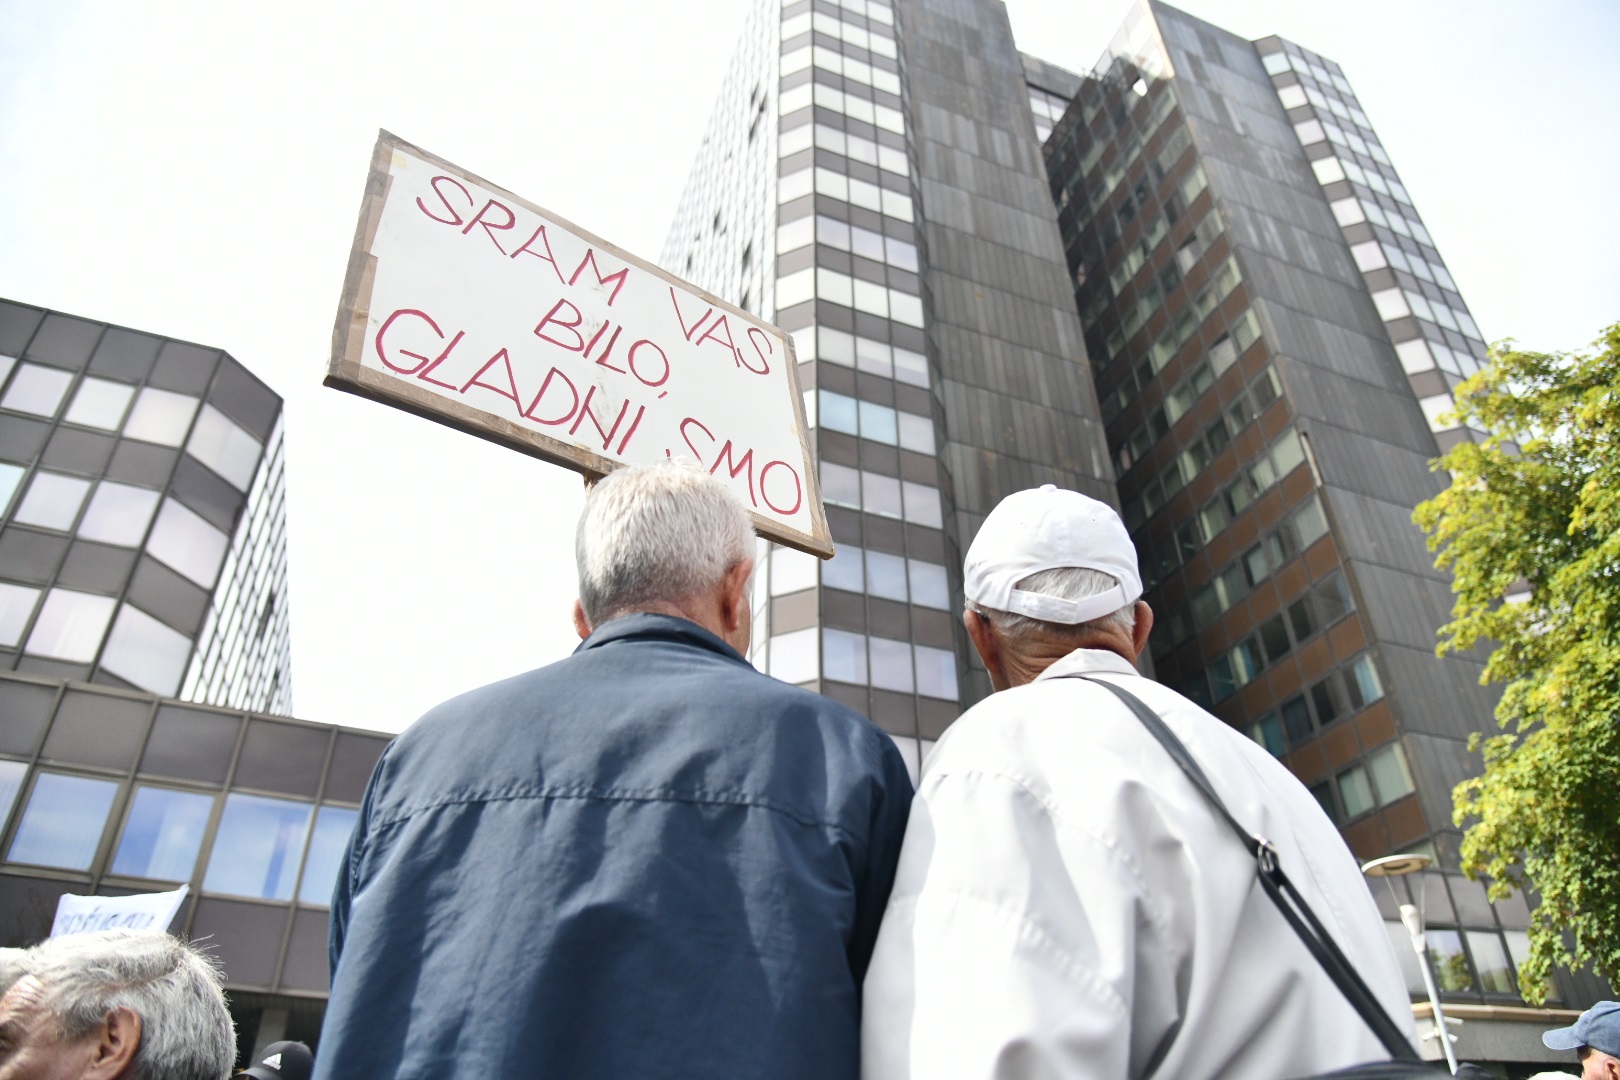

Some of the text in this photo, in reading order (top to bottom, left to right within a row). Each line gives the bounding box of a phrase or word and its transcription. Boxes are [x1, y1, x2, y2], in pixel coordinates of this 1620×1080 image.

[416, 175, 773, 376] SRAM VAS
[533, 298, 670, 399] BILO,
[375, 309, 802, 515] GLADNI SMO
